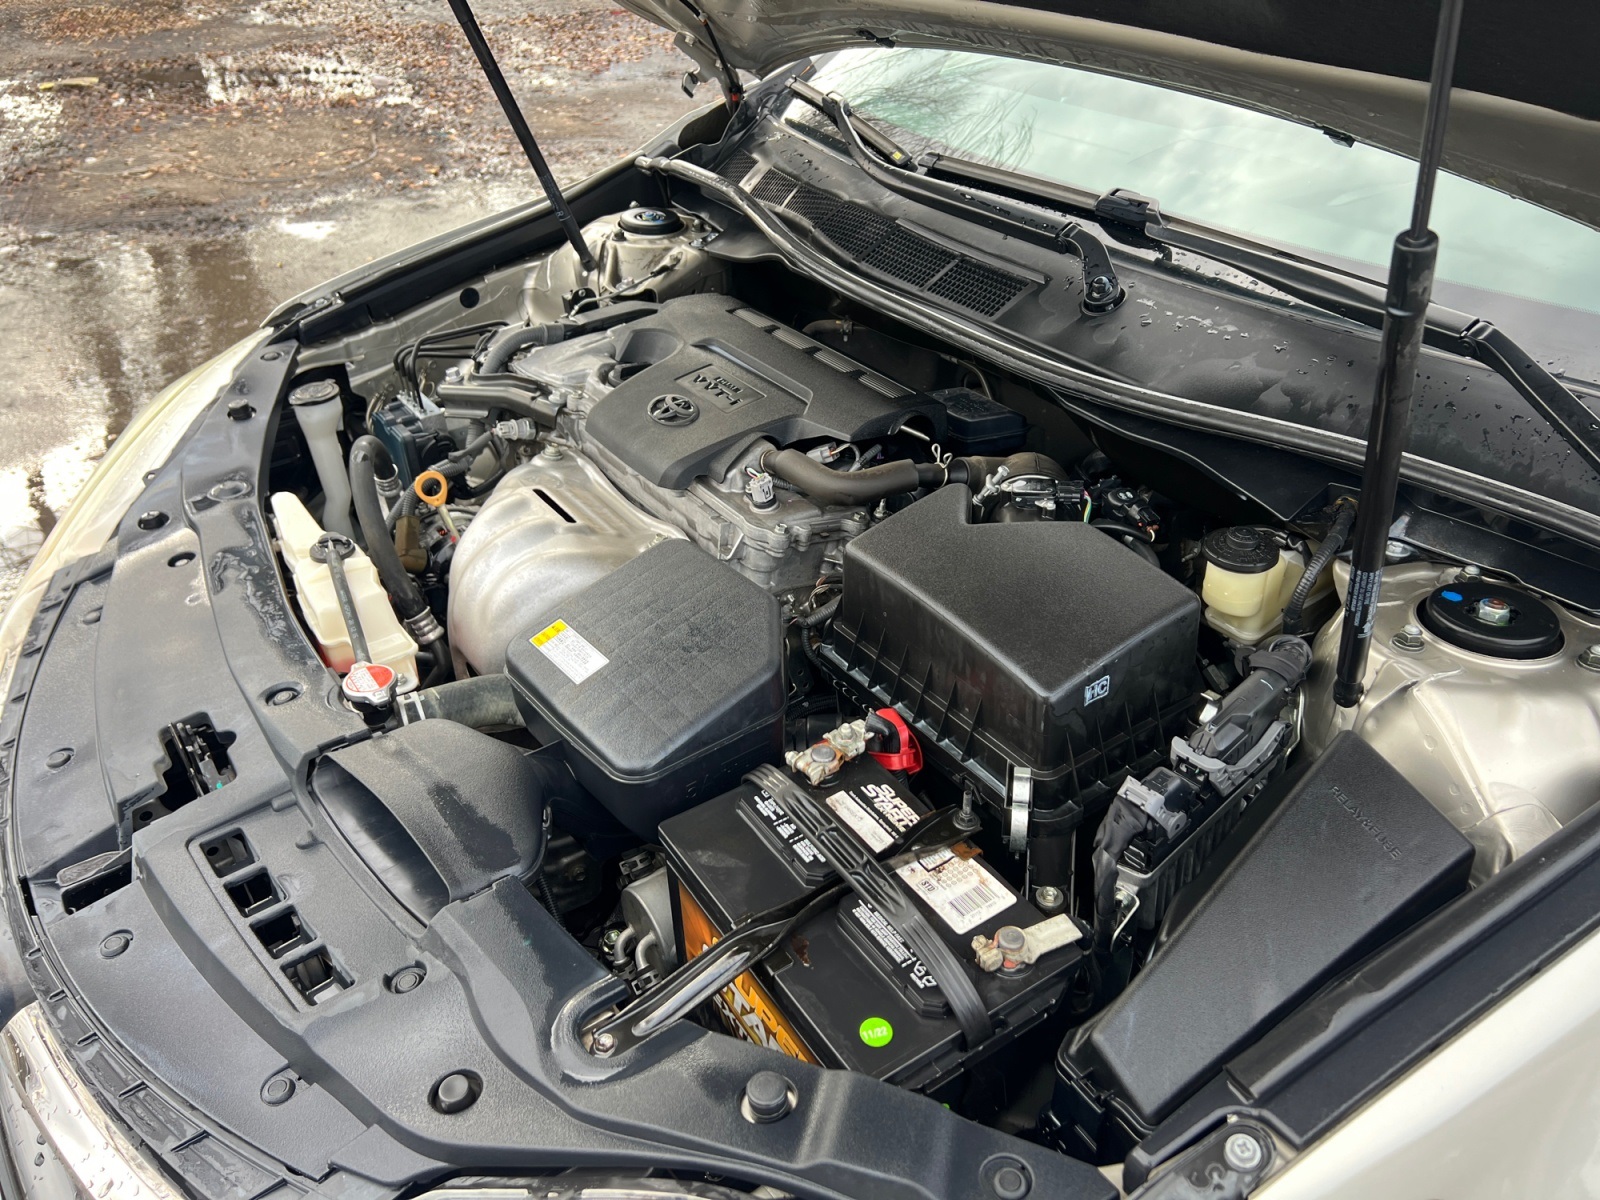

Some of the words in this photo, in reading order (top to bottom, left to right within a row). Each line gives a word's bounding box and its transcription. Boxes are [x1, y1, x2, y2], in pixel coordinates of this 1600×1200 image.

[693, 374, 743, 406] VVT-i
[860, 784, 914, 832] START
[876, 784, 920, 827] SUPER
[862, 1026, 888, 1040] 11/22
